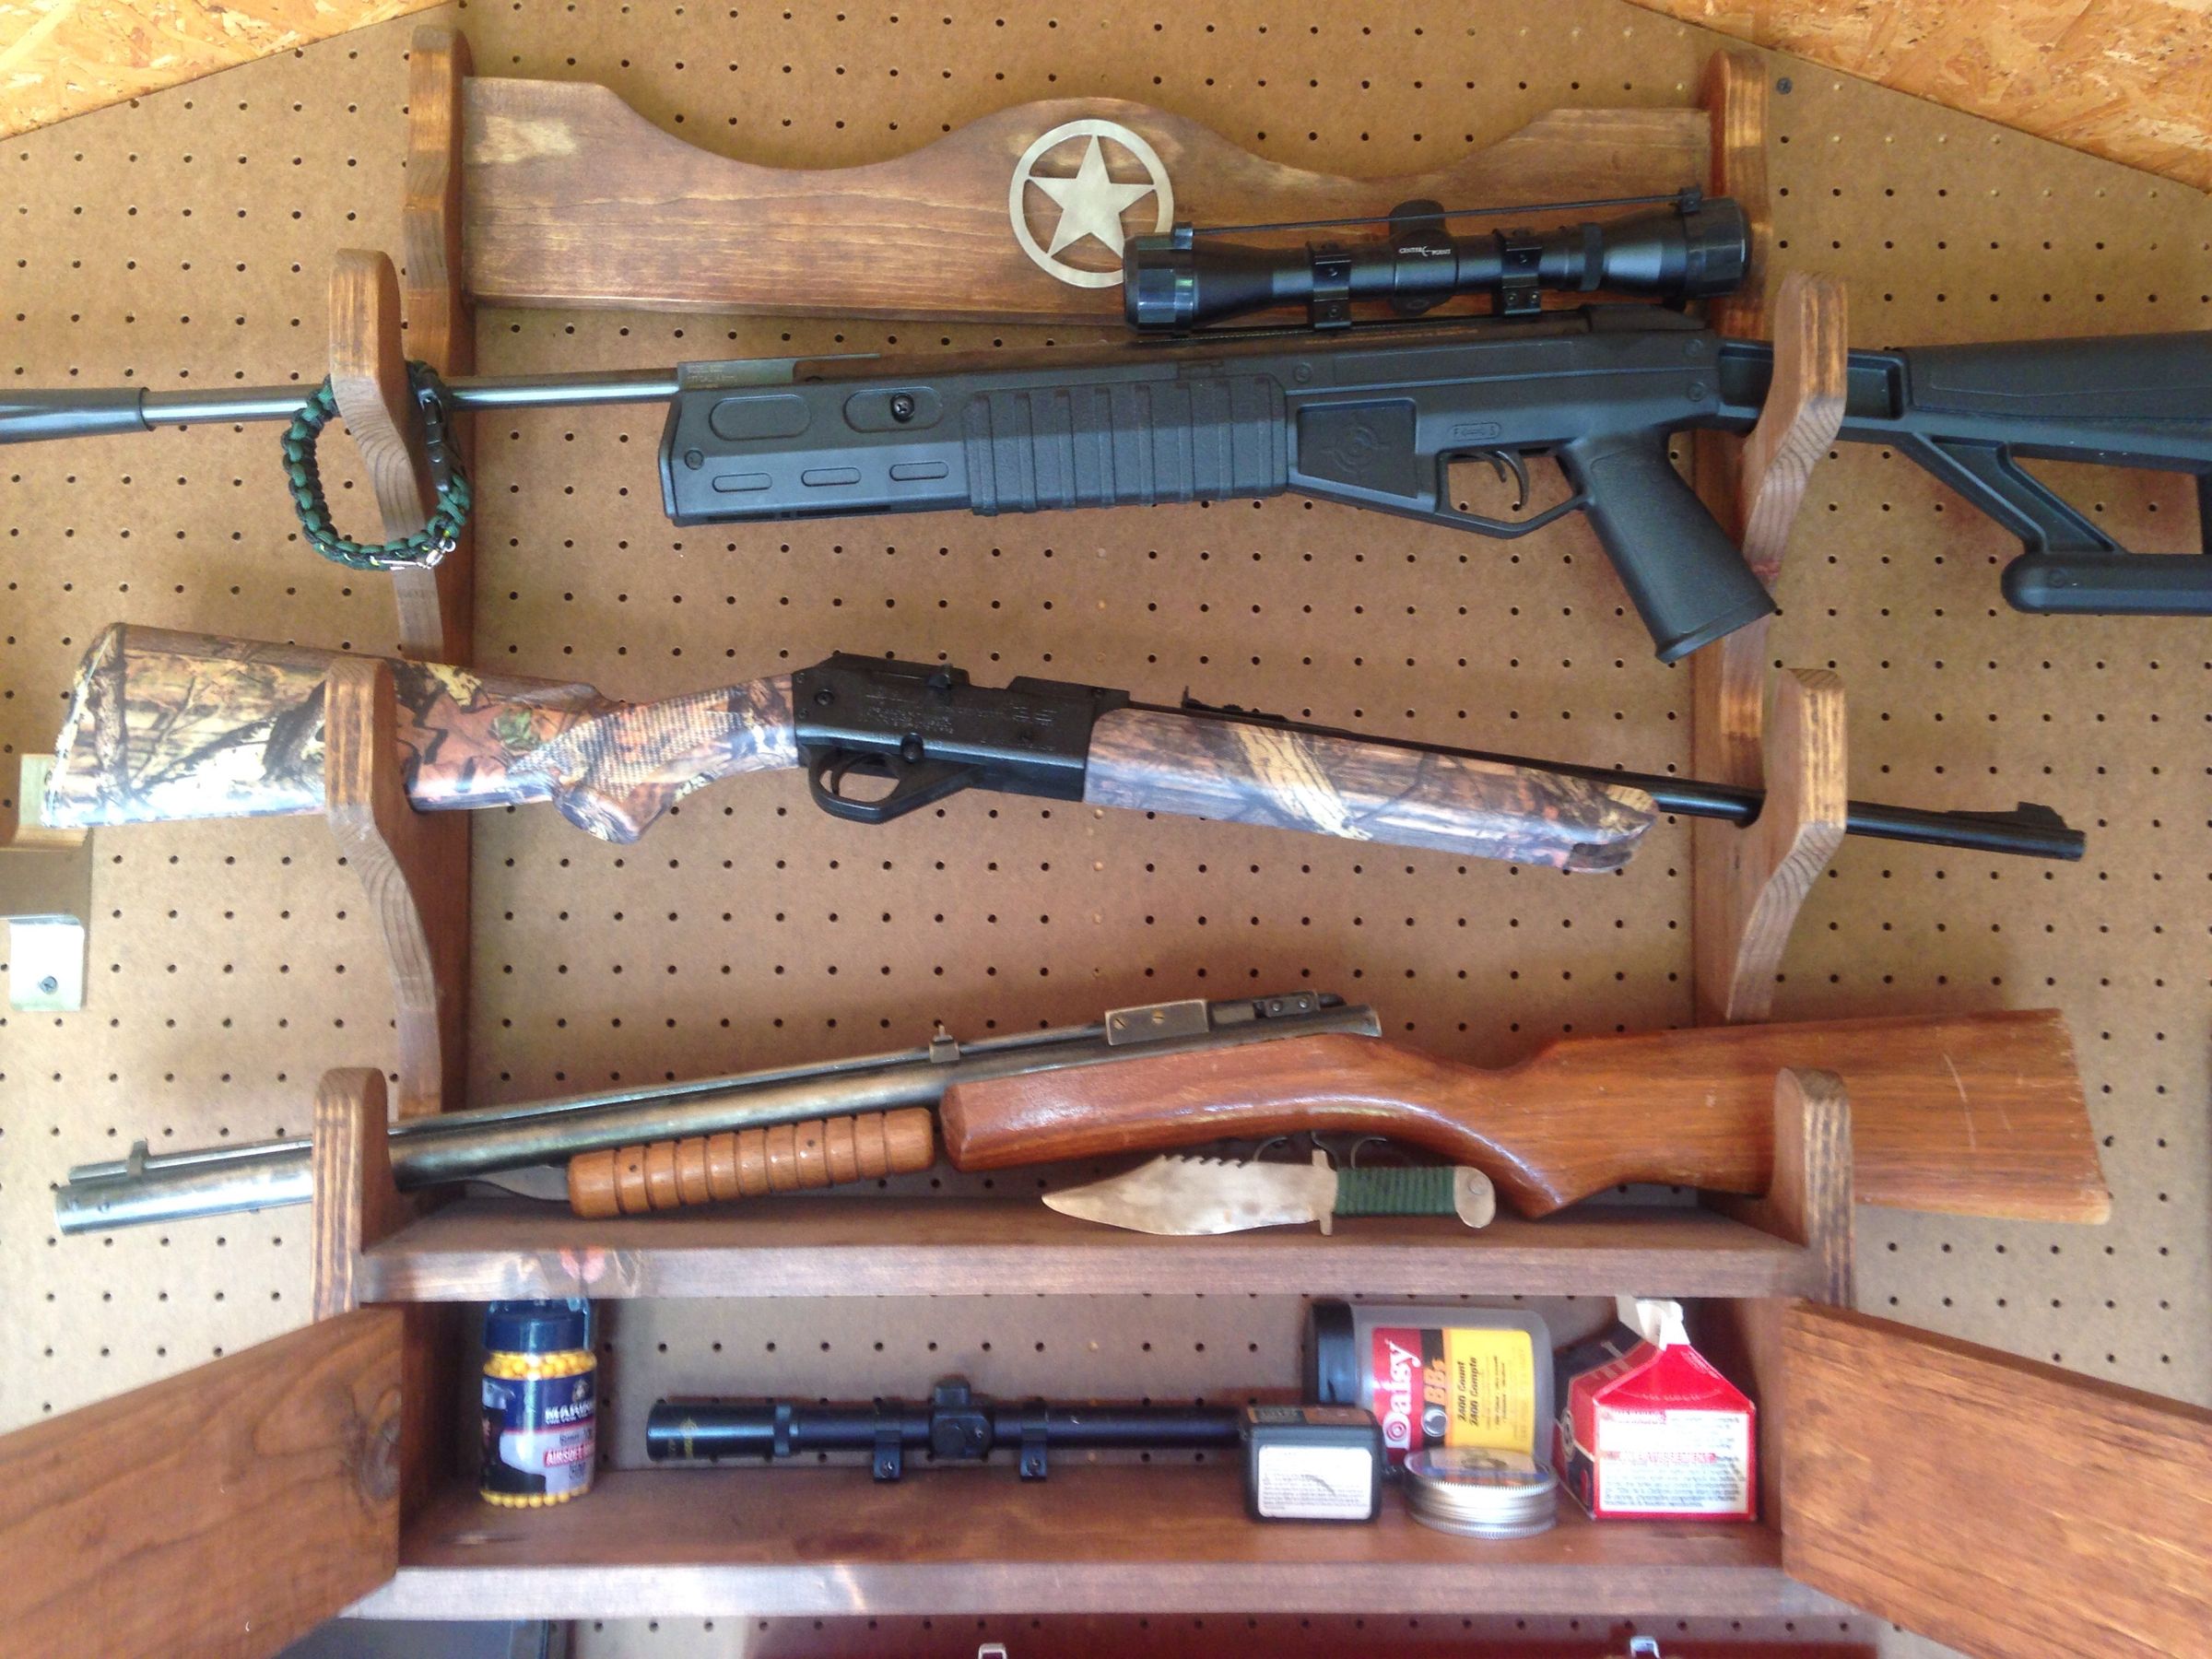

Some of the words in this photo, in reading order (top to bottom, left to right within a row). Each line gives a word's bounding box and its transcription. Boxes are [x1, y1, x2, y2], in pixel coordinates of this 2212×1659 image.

[1456, 1360, 1467, 1393] Count
[1373, 1337, 1422, 1452] Daisy
[1457, 1394, 1467, 1423] 2400
[1468, 1401, 1479, 1427] 2400
